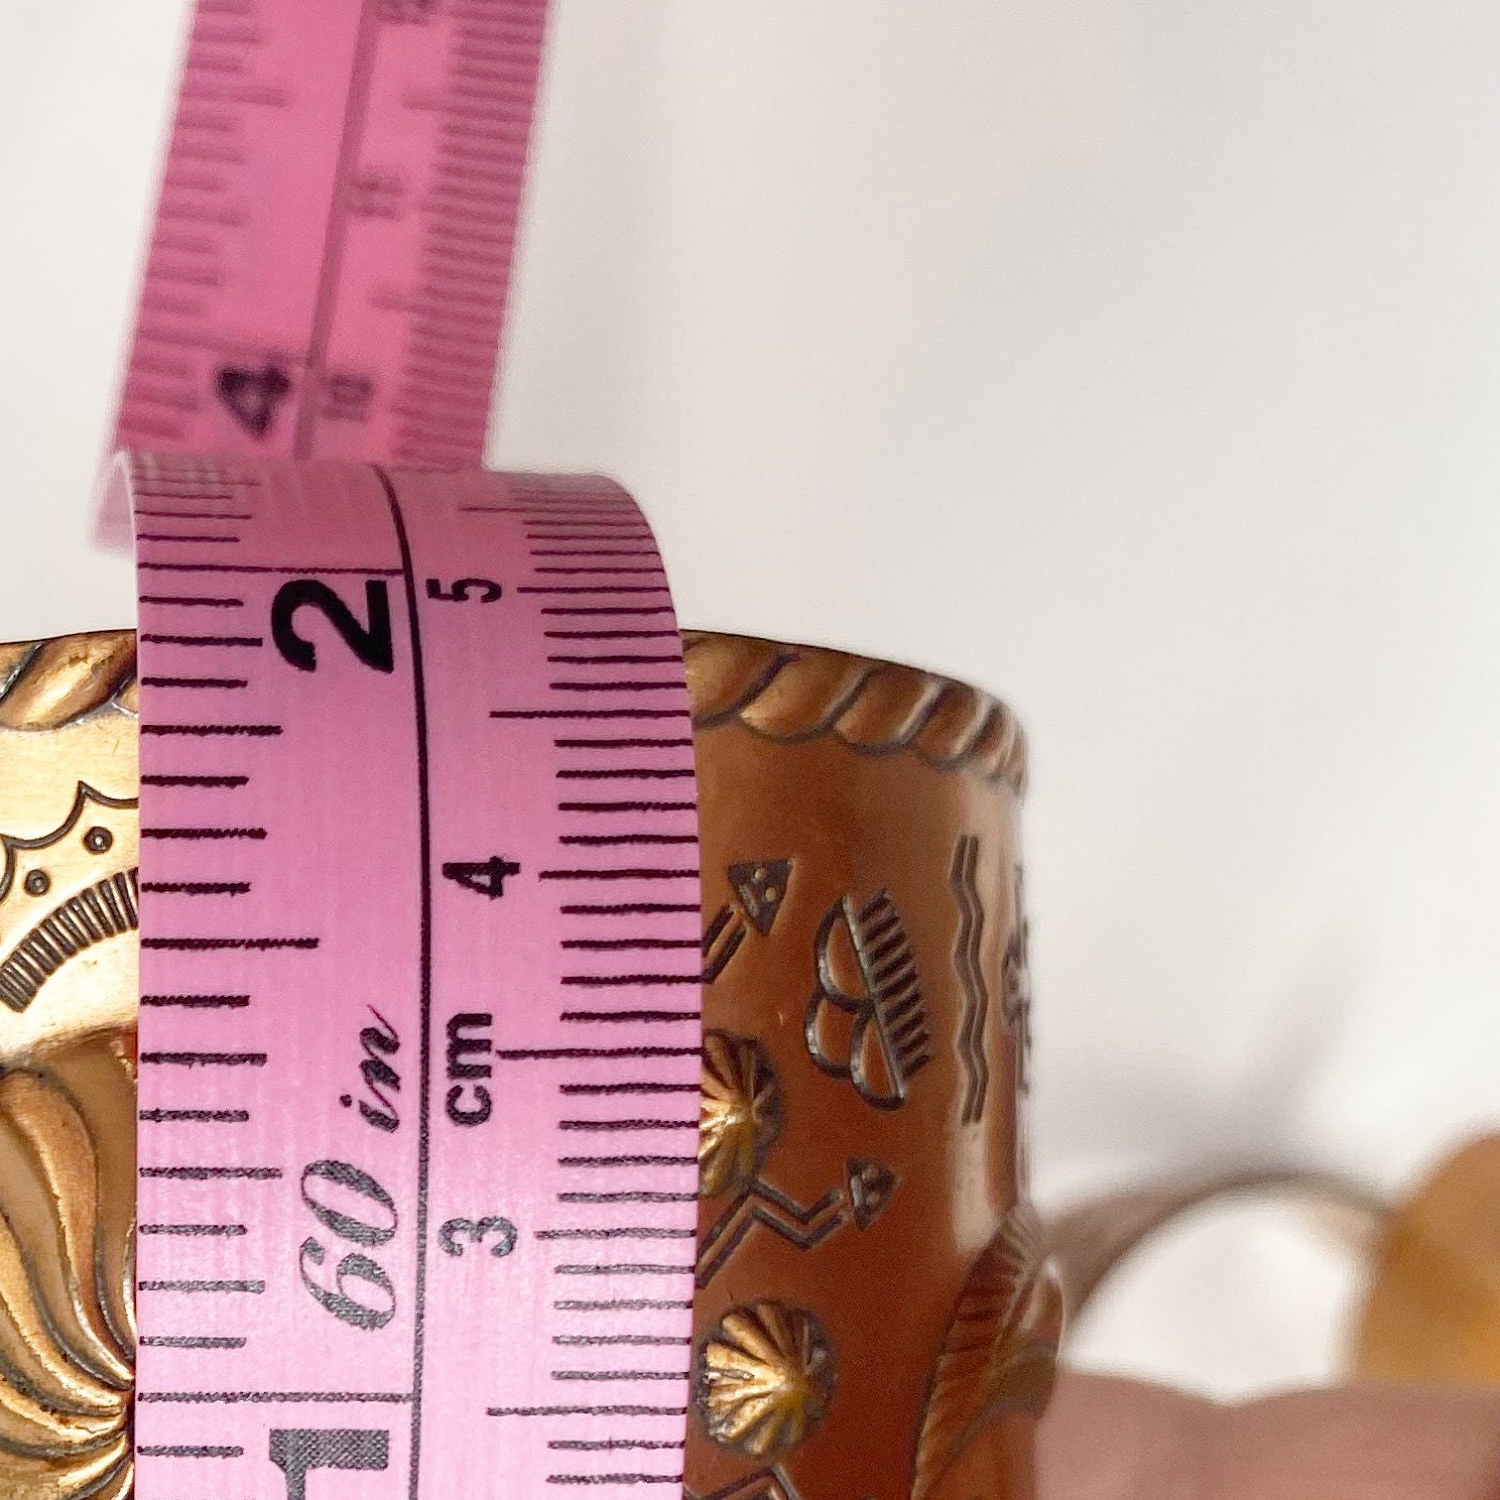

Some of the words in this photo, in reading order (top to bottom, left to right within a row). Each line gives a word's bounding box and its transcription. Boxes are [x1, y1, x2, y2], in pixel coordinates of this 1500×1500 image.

[216, 364, 292, 440] 4
[271, 578, 394, 674] 2
[425, 576, 503, 604] 5
[442, 856, 521, 899] 4
[339, 1003, 401, 1133] in
[445, 1012, 494, 1127] cm
[299, 1157, 400, 1331] 60
[436, 1214, 519, 1258] 3
